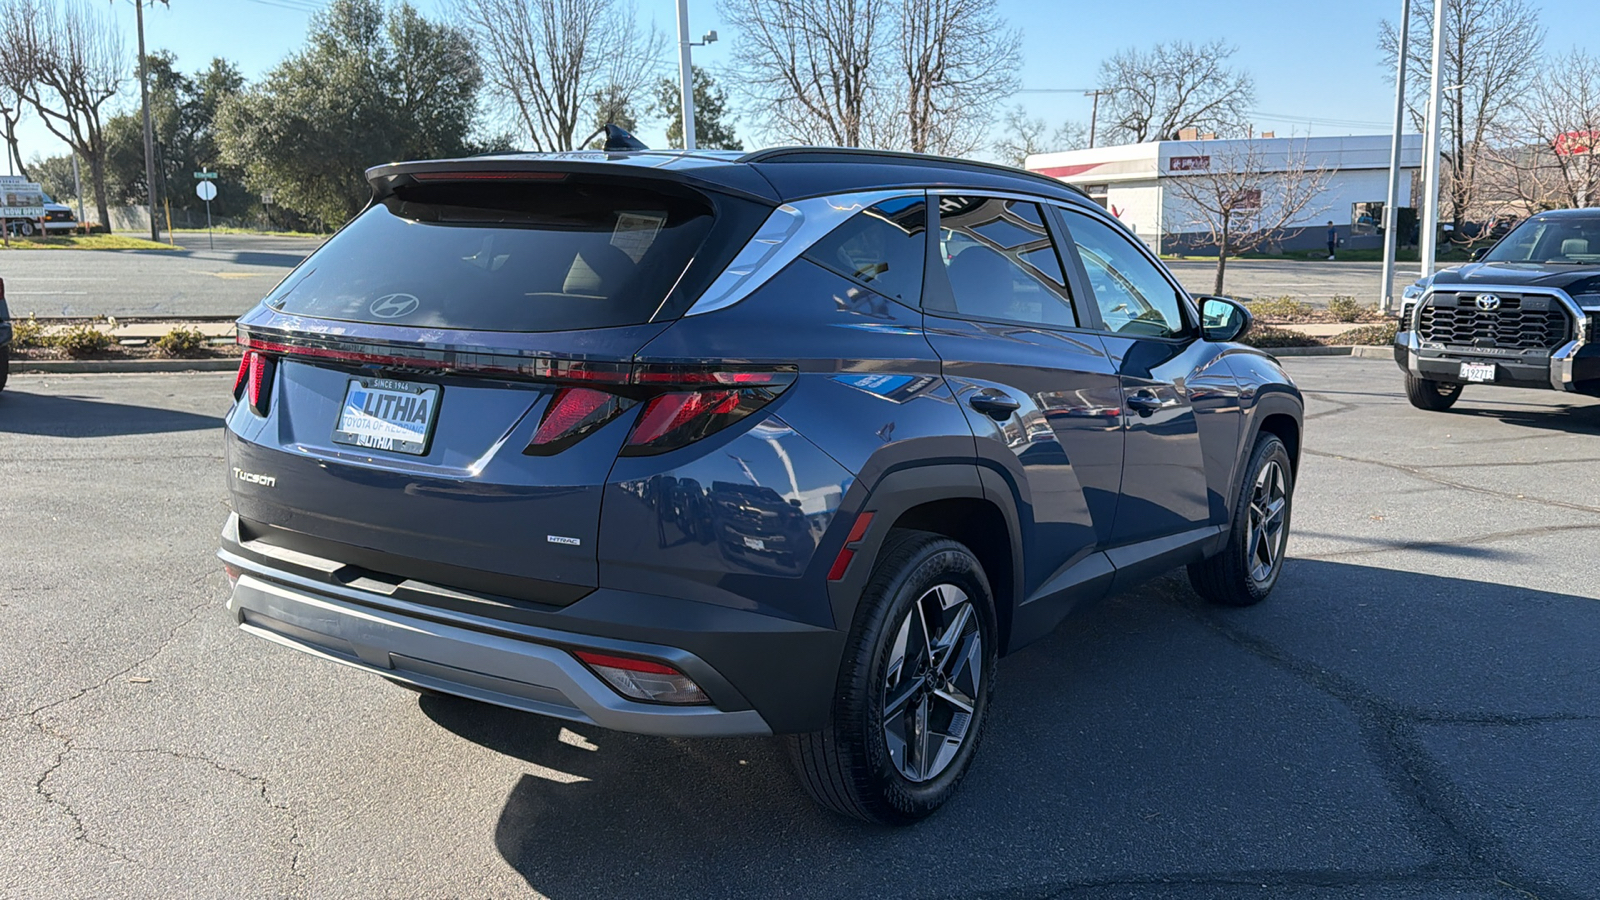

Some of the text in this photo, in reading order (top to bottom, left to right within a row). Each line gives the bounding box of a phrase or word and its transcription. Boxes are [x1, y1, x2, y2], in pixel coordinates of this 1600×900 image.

[4, 207, 20, 216] NOW
[374, 379, 409, 391] SINCE 1946
[363, 392, 428, 424] LITHIA
[344, 416, 425, 435] TOYOTA OF REDDING
[365, 434, 394, 451] LITHIA
[232, 466, 276, 488] Tucson
[549, 536, 578, 545] HTRAC
